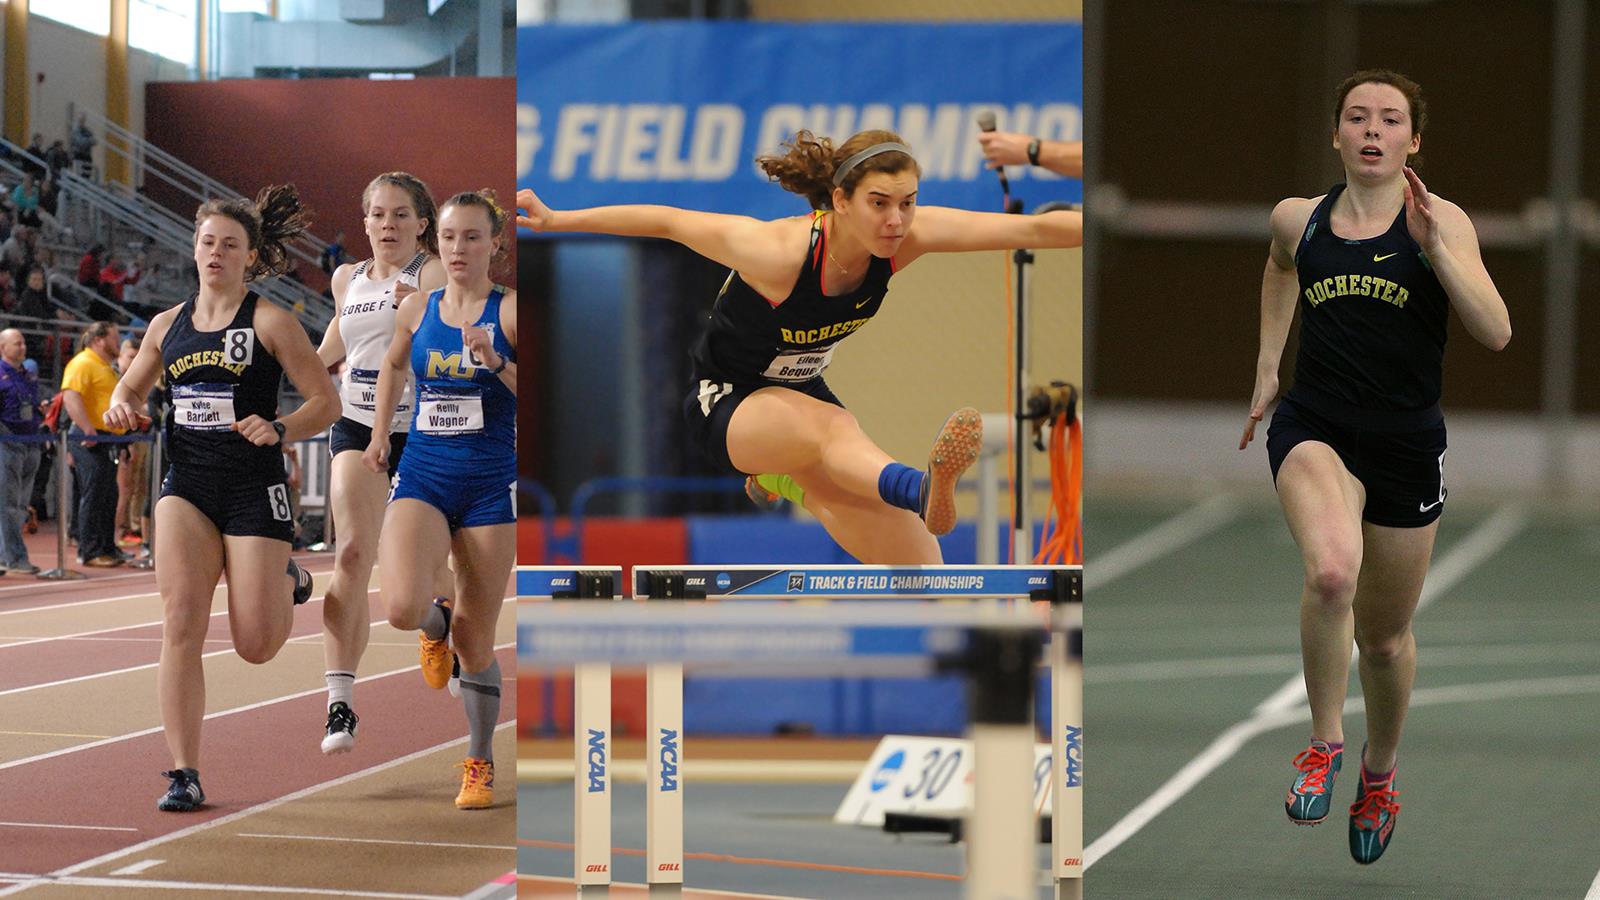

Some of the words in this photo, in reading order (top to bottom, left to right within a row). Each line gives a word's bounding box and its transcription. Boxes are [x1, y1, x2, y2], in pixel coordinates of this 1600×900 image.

[550, 103, 746, 182] FIELD
[1304, 274, 1410, 308] ROCHESTER
[378, 299, 387, 311] F
[230, 330, 248, 362] 8
[191, 401, 211, 410] Kylee
[186, 411, 220, 422] Bartlett
[429, 415, 469, 428] Wagner
[274, 486, 288, 520] 8
[550, 577, 572, 586] GILL
[686, 577, 706, 586] GILL
[808, 575, 846, 590] TRACK
[847, 575, 856, 590] &
[856, 575, 888, 590] FIELD
[889, 575, 985, 590] CHAMPIONSHIPS
[1028, 576, 1048, 585] GILL
[588, 728, 606, 793] NCAA
[660, 728, 678, 792] NCAA
[1066, 725, 1082, 788] NCAA
[903, 747, 963, 801] 30
[585, 864, 608, 873] GILL
[658, 863, 680, 872] GILL
